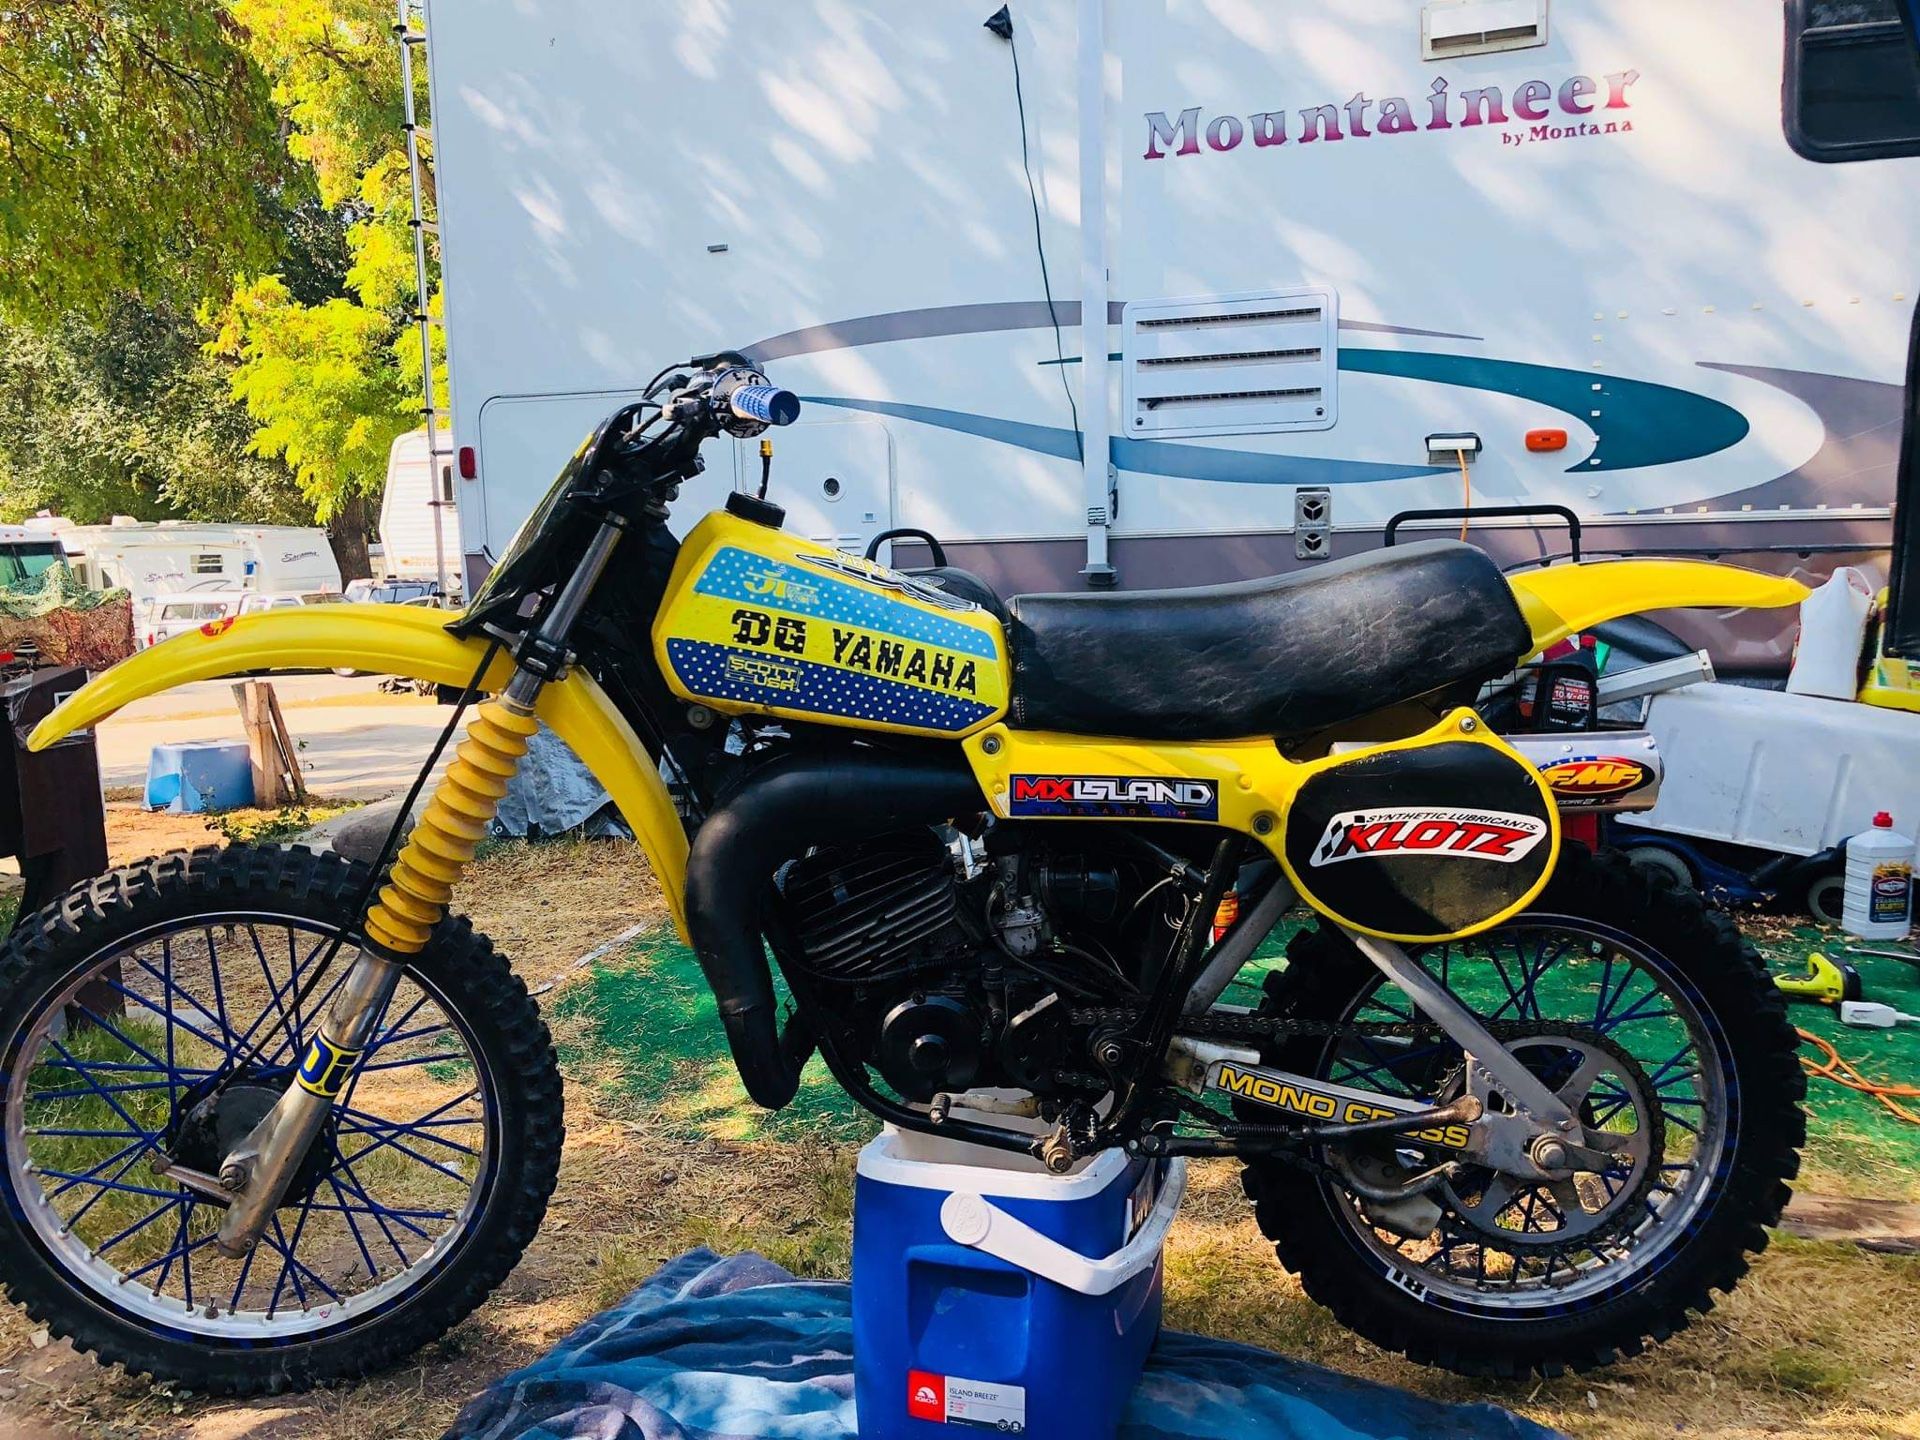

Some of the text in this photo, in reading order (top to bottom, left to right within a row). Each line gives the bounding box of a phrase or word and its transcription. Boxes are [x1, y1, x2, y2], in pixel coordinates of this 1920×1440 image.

[1144, 69, 1640, 159] Mountaineer
[1502, 120, 1633, 146] by Montana
[731, 609, 977, 696] DG YAMAHA
[730, 656, 798, 679] SCOTT
[753, 673, 797, 691] USA
[1543, 764, 1642, 786] FMF
[1366, 812, 1539, 832] SYNTHETIC LUBRICANTS
[1332, 820, 1537, 858] KLOTZ
[1219, 1066, 1470, 1149] MONO CSS
[949, 1387, 974, 1398] ISLAND
